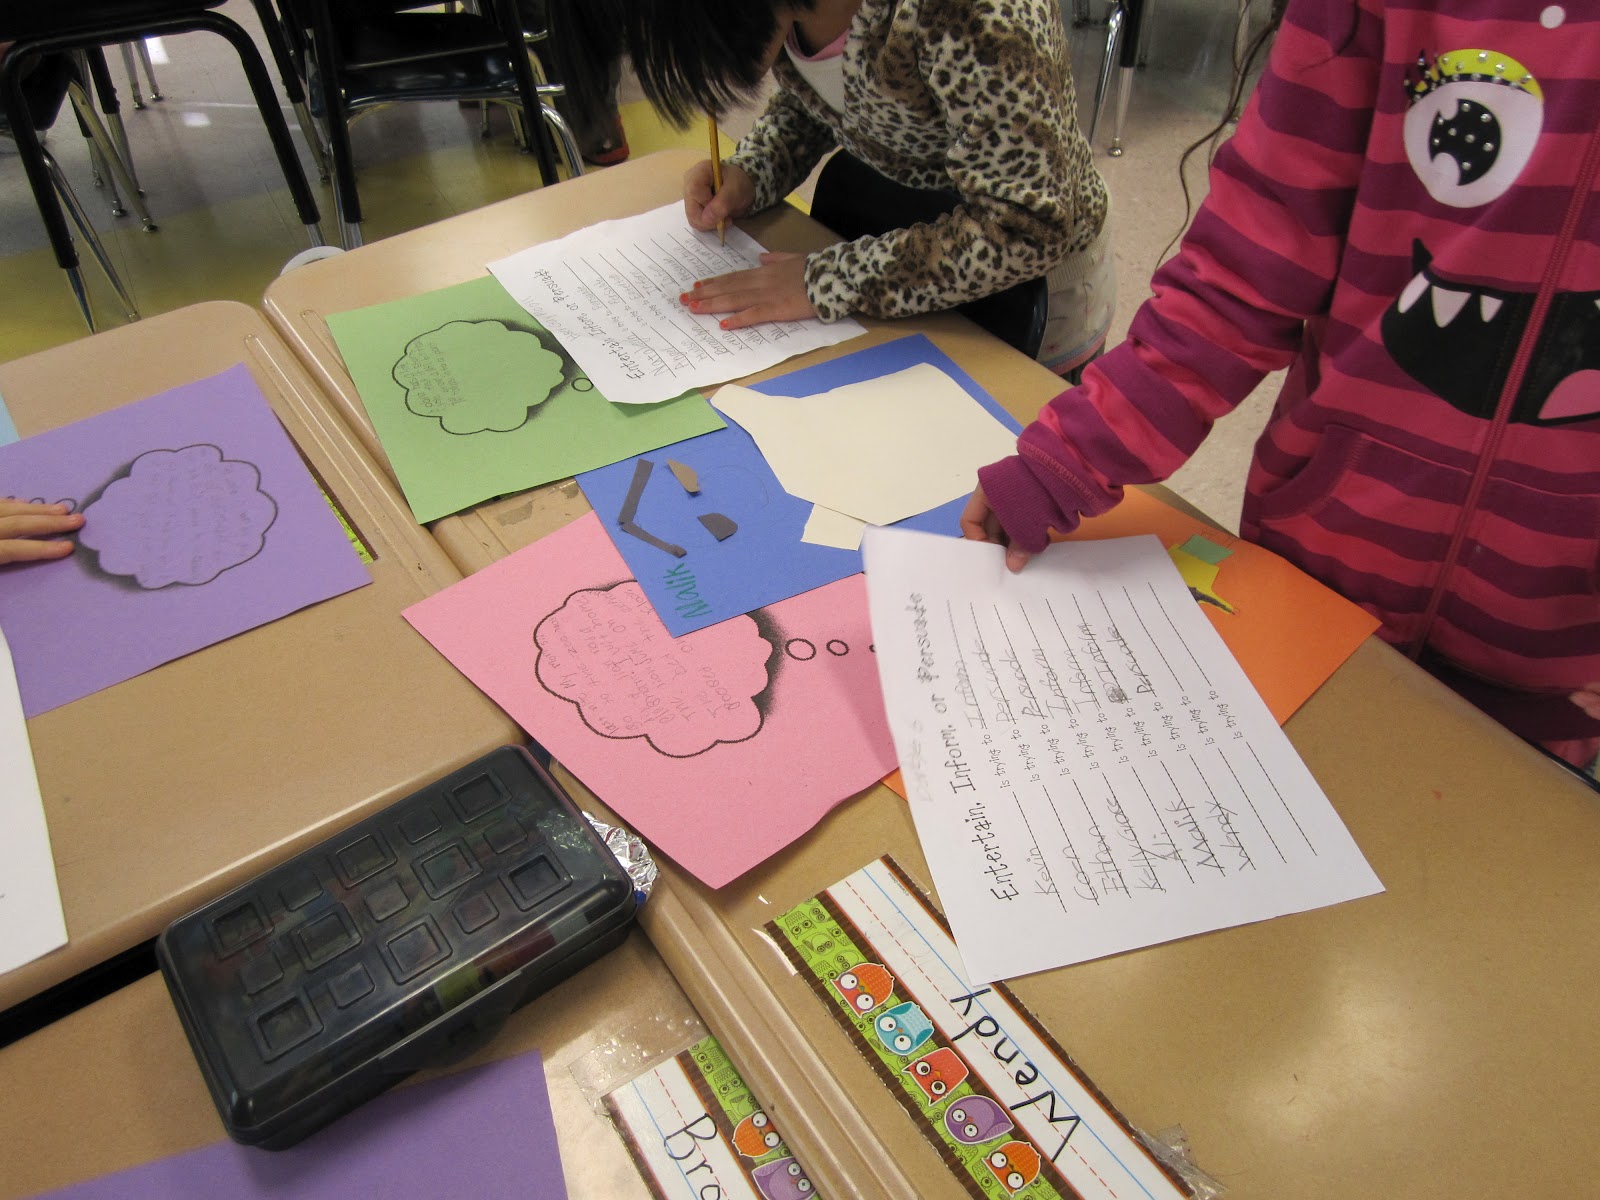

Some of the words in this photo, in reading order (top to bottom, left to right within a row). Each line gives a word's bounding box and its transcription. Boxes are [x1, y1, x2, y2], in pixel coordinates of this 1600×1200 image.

[533, 268, 570, 304] Persuade
[564, 301, 580, 311] or
[663, 563, 713, 619] Malik
[908, 592, 939, 682] Persuade
[1030, 647, 1073, 718] Inform
[1062, 648, 1102, 713] Inform
[929, 692, 949, 713] or
[1176, 695, 1192, 705] to
[1204, 690, 1219, 700] to
[1121, 707, 1135, 717] to
[1149, 701, 1164, 711] to
[1213, 703, 1240, 728] trying
[1037, 723, 1051, 733] to
[1065, 718, 1080, 729] to
[1093, 712, 1107, 723] to
[1157, 714, 1184, 740] trying
[1185, 708, 1212, 733] trying
[978, 733, 993, 744] to
[1008, 729, 1022, 738] to
[1101, 725, 1126, 752] trying
[1129, 720, 1154, 746] trying
[1202, 737, 1215, 745] is
[1045, 737, 1068, 764] trying
[1073, 731, 1098, 758] trying
[1145, 749, 1158, 757] is
[1174, 743, 1187, 751] is
[985, 748, 1009, 776] trying
[1016, 742, 1038, 769] trying
[1087, 761, 1100, 769] is
[1116, 755, 1129, 763] is
[1028, 773, 1040, 781] is
[1057, 767, 1070, 775] is
[998, 779, 1011, 788] is
[1164, 800, 1224, 867] Malik
[1204, 801, 1250, 871] Wendy
[1027, 846, 1058, 896] Kevin
[950, 988, 1081, 1162] Wendy
